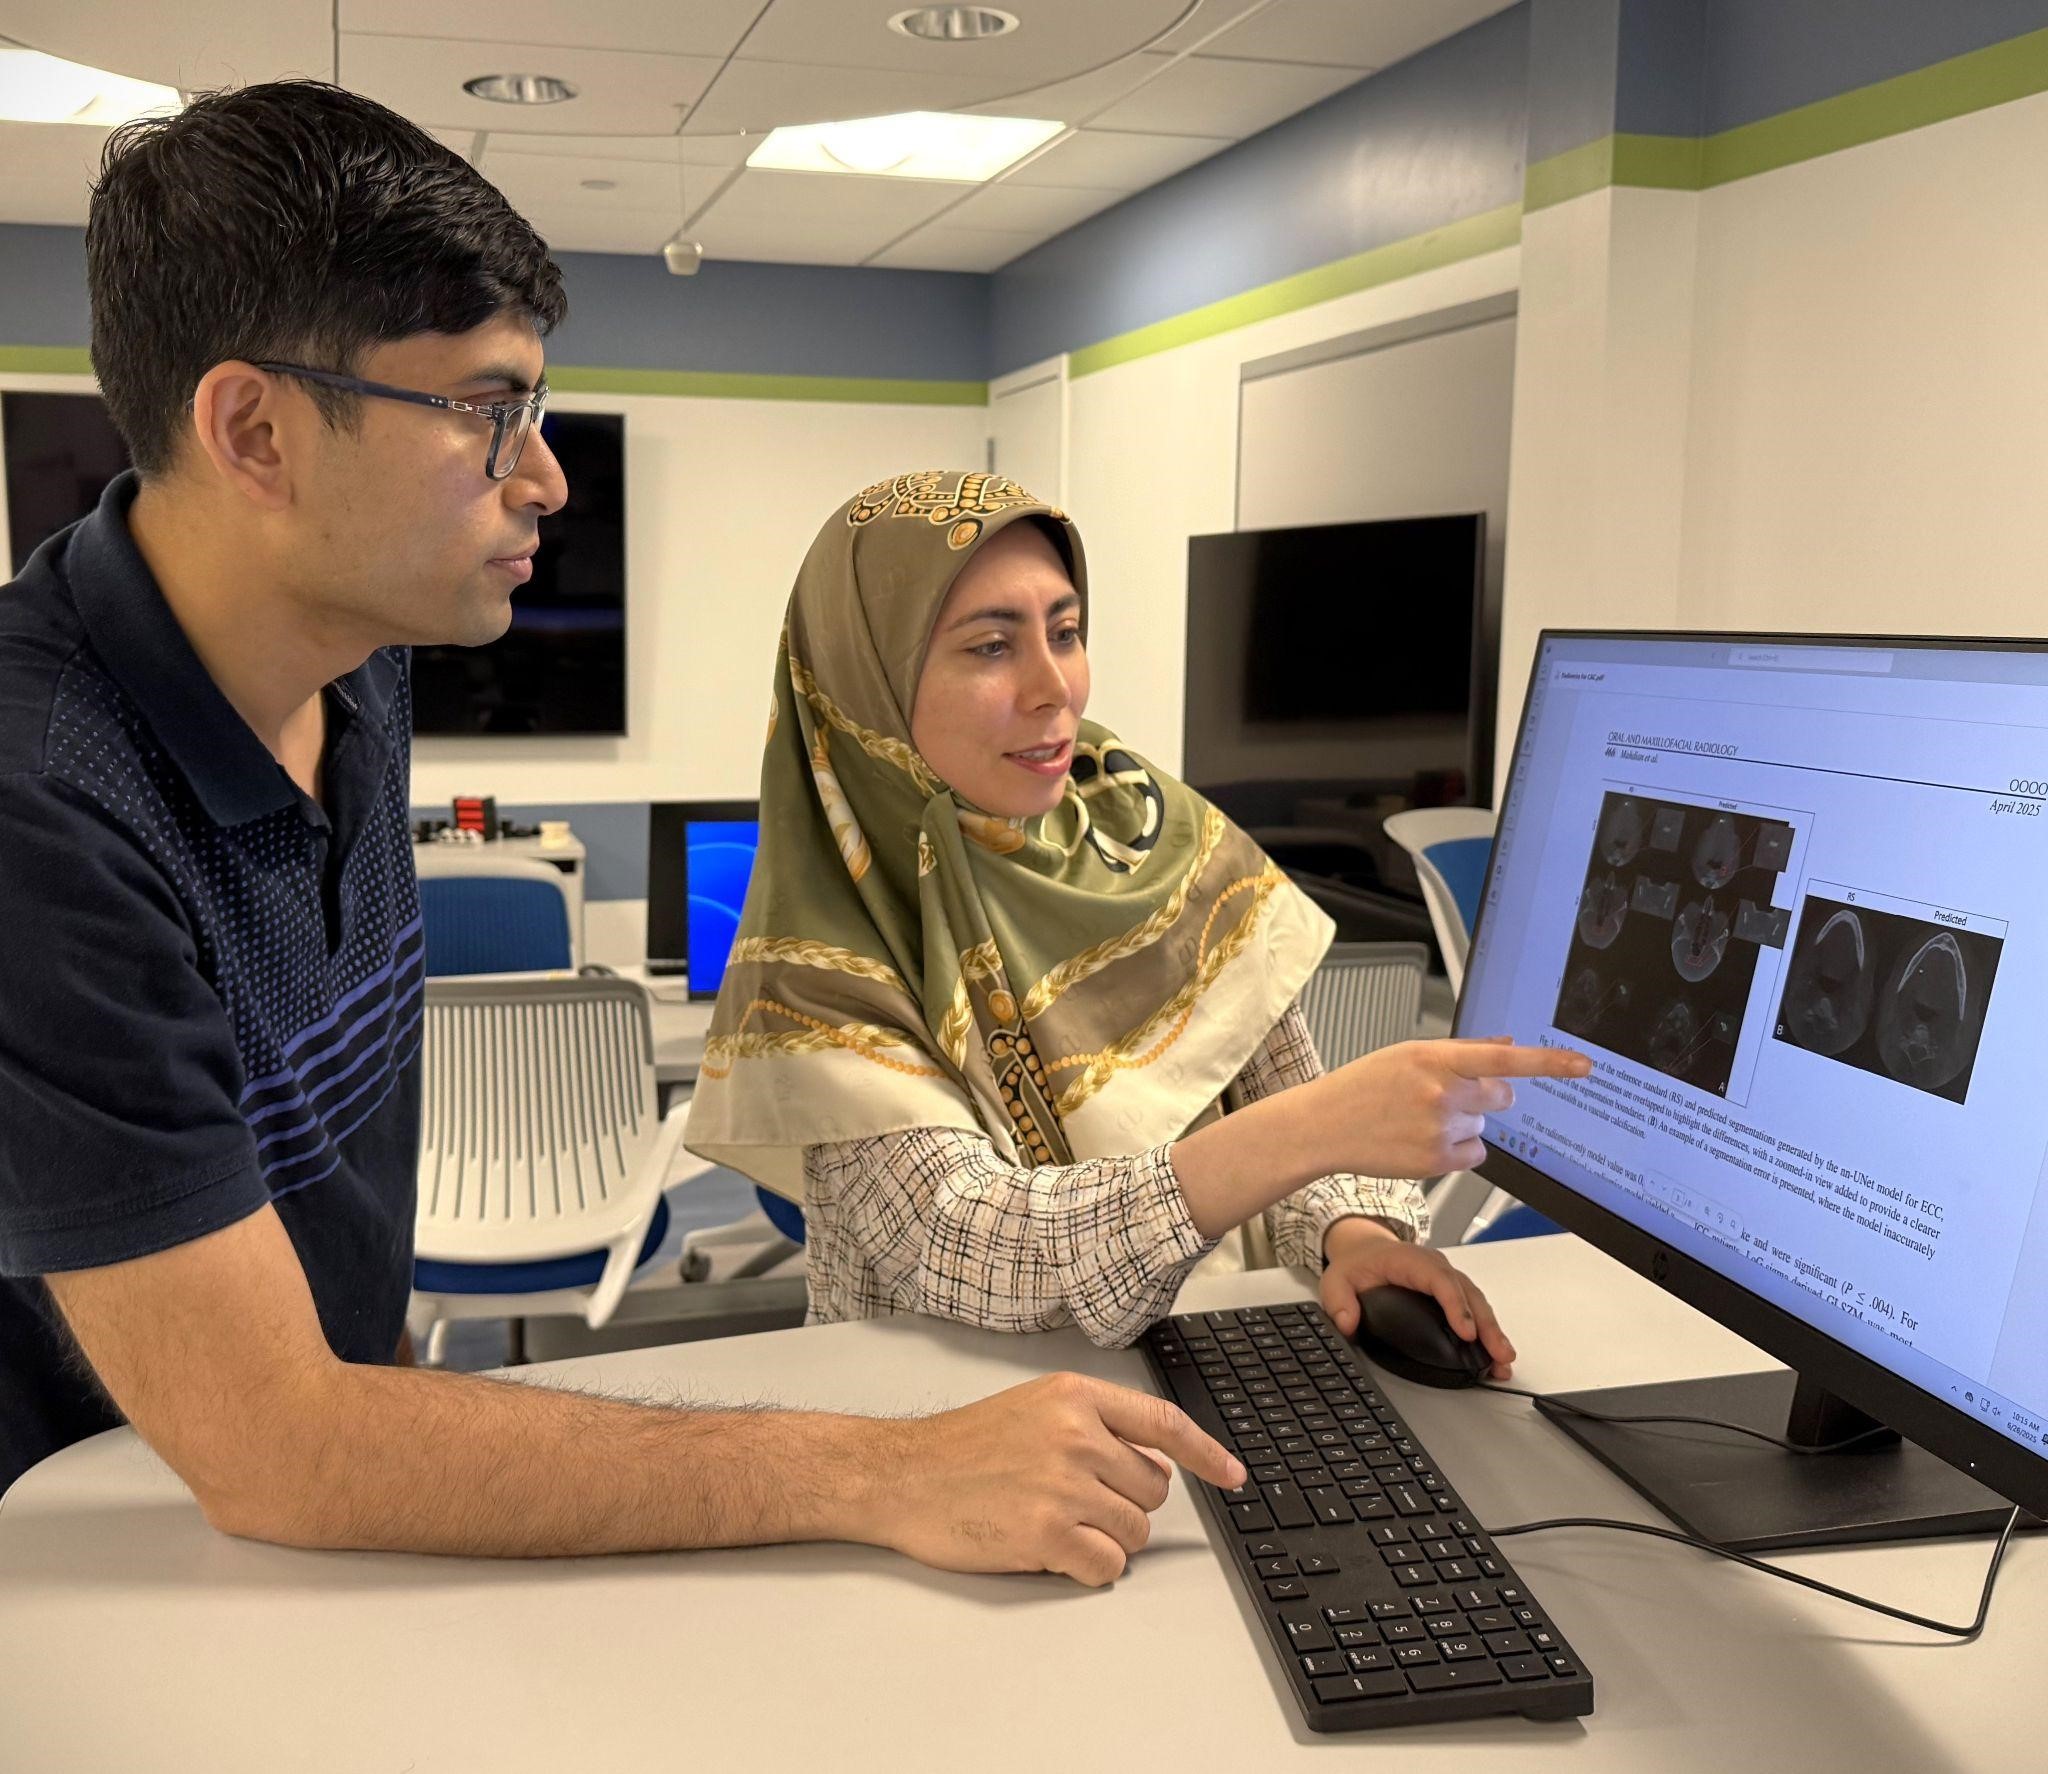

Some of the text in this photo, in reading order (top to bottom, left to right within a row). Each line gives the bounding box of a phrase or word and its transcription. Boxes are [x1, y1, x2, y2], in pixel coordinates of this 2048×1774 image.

[1608, 732, 1737, 756] ORAL AND MAXILLOFACIAL RADIOLOGY
[1719, 801, 1737, 810] Predicted
[1990, 800, 2041, 816] April 2025
[1847, 892, 1855, 901] RS
[1934, 911, 1967, 925] Predicted
[1776, 1025, 1784, 1037] B
[1717, 1081, 1726, 1092] A
[1588, 1106, 1610, 1121] vascular
[1611, 1117, 1644, 1138] calcification.
[1535, 1122, 1545, 1133] the
[1545, 1128, 1586, 1155] radiomics-only
[1587, 1150, 1606, 1165] model
[1607, 1161, 1623, 1174] value
[1625, 1170, 1637, 1182] was
[1598, 1062, 1606, 1071] of
[1606, 1064, 1615, 1075] the
[1616, 1070, 1642, 1087] reference
[1643, 1082, 1668, 1098] standard
[1669, 1091, 1683, 1106] (RS)
[1684, 1100, 1697, 1111] and
[1697, 1106, 1727, 1124] predicted
[1729, 1120, 1775, 1145] segmentations
[1777, 1141, 1813, 1162] generated
[1814, 1154, 1824, 1169] by
[1826, 1160, 1838, 1173] the
[1840, 1169, 1874, 1189] nn-UNet
[1877, 1185, 1903, 1201] model
[1905, 1194, 1919, 1208] for
[1920, 1200, 1943, 1221] ECC,
[1587, 1075, 1622, 1094] egmentations
[1623, 1089, 1632, 1099] are
[1633, 1095, 1665, 1113] overlapped
[1665, 1108, 1672, 1117] to
[1673, 1110, 1700, 1130] highlight
[1701, 1123, 1712, 1135] the
[1713, 1129, 1749, 1153] differences,
[1753, 1147, 1768, 1161] with
[1775, 1158, 1812, 1181] zoomed-in
[1815, 1175, 1833, 1190] view
[1834, 1185, 1858, 1202] added
[1859, 1195, 1868, 1206] to
[1869, 1201, 1900, 1221] provide
[1910, 1218, 1940, 1238] clearer
[1570, 1080, 1579, 1091] the
[1580, 1086, 1614, 1107] segmentation
[1615, 1100, 1644, 1121] boundaries.
[1647, 1116, 1658, 1128] (B)
[1658, 1121, 1668, 1132] An
[1669, 1128, 1694, 1145] example
[1695, 1139, 1704, 1149] of
[1709, 1147, 1752, 1171] segmentation
[1753, 1167, 1771, 1180] error
[1771, 1172, 1778, 1184] is
[1779, 1179, 1815, 1203] presented,
[1818, 1197, 1841, 1213] where
[1842, 1206, 1855, 1220] the
[1857, 1215, 1882, 1233] model
[1884, 1225, 1935, 1259] inaccurately
[1753, 1238, 1768, 1251] and
[1772, 1247, 1791, 1263] were
[1795, 1259, 1837, 1288] significant
[1841, 1281, 1853, 1295] (P
[1869, 1297, 1894, 1319] .004).
[1901, 1311, 1918, 1330] For
[2007, 1421, 2038, 1444] 6/26/2025
[2012, 1411, 2040, 1432] 10:15 AM
